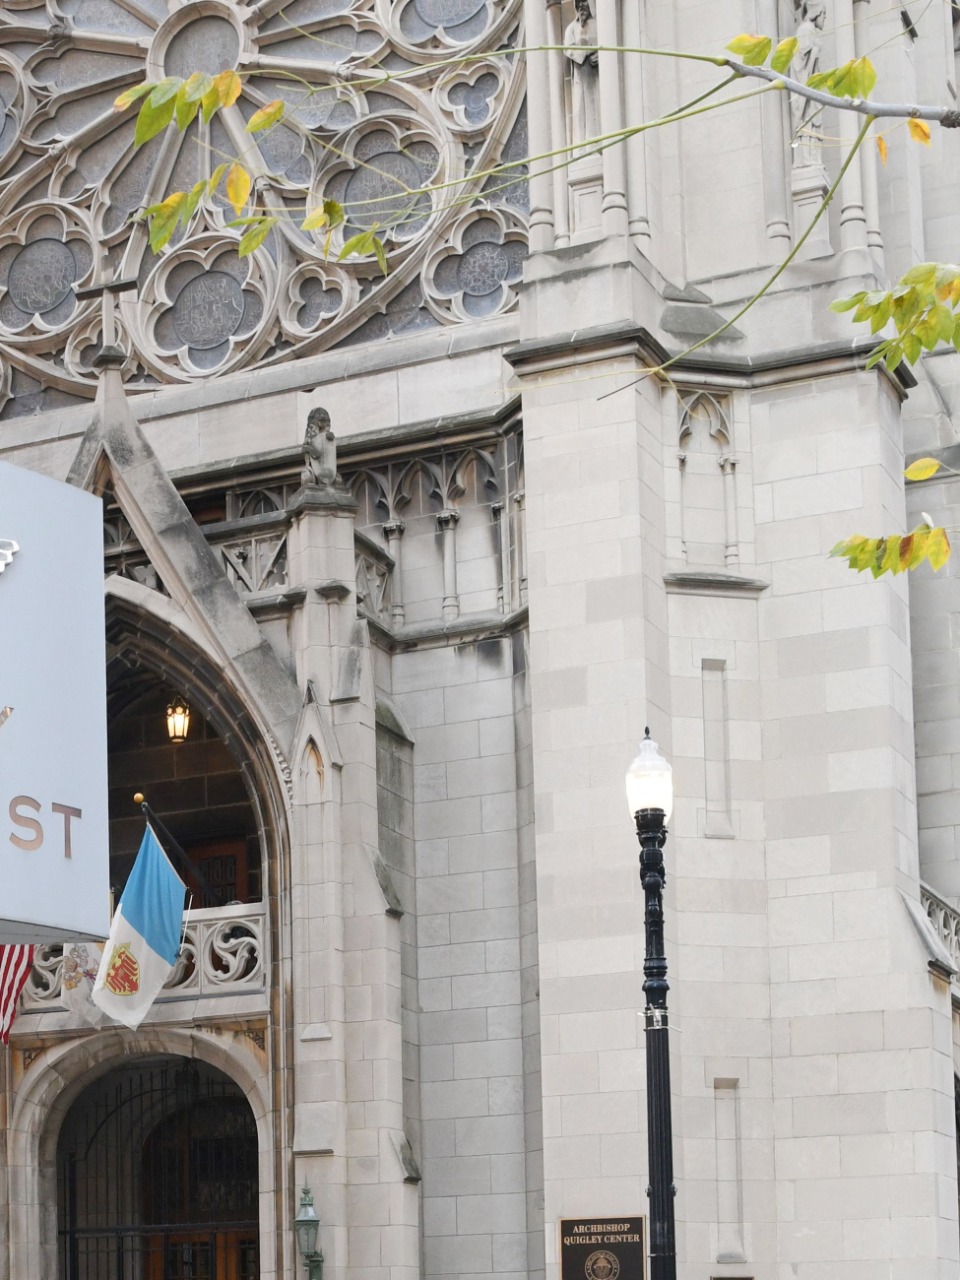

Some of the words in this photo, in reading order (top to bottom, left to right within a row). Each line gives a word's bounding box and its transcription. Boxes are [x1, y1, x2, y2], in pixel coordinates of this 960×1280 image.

[572, 1223, 631, 1233] ARCHBISHOP
[563, 1235, 603, 1246] QUIGLEY
[603, 1234, 640, 1244] CENTER
